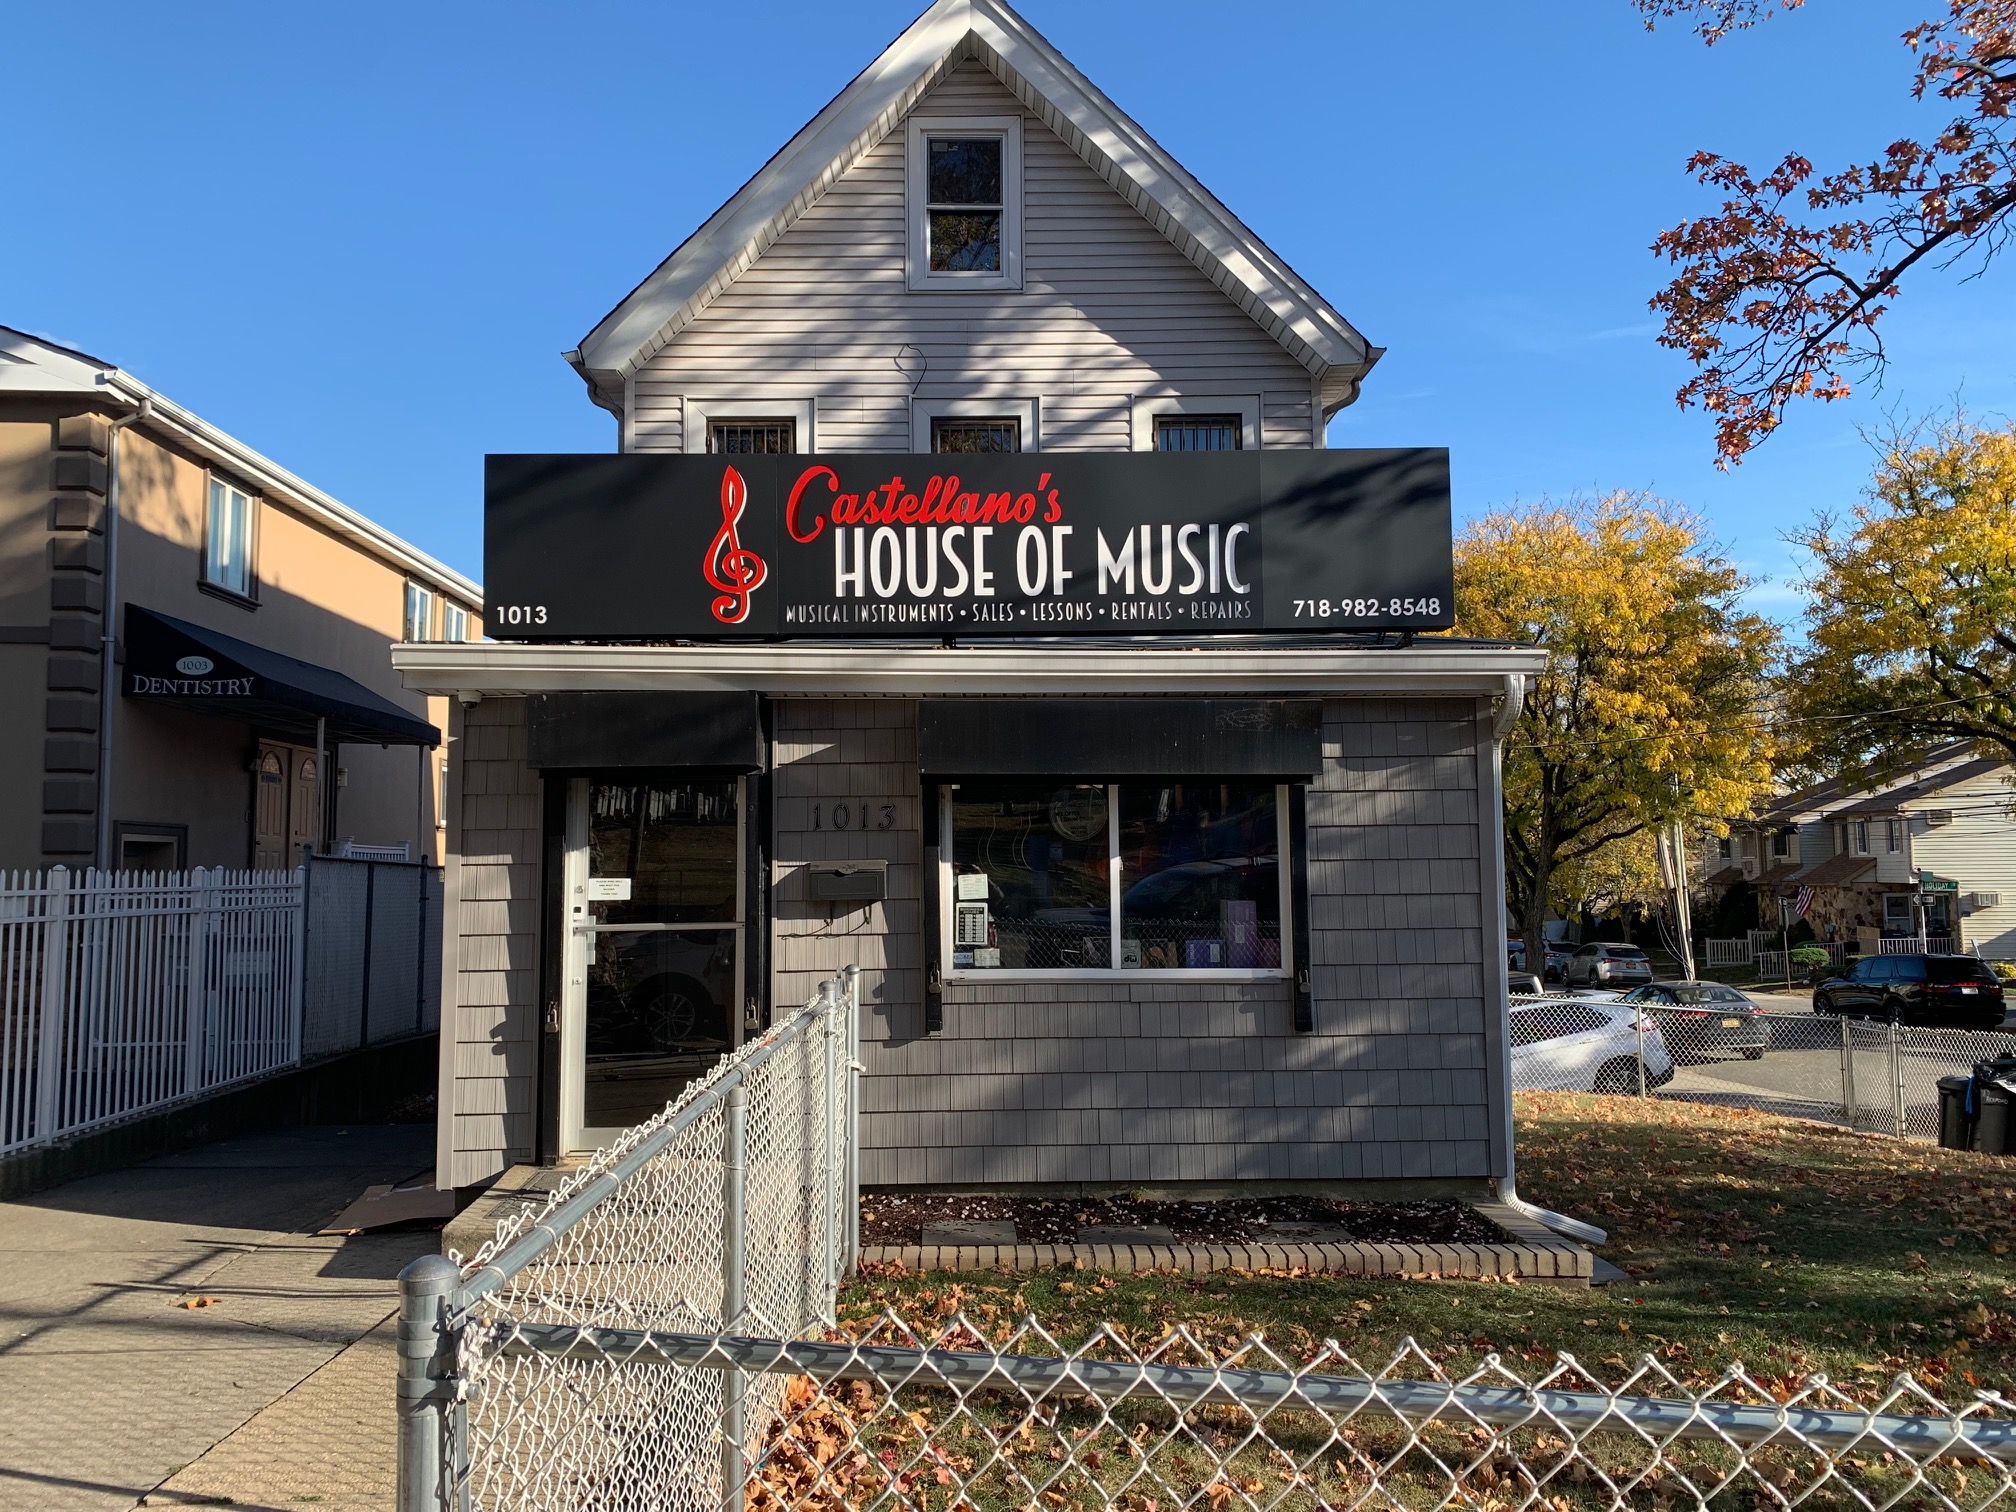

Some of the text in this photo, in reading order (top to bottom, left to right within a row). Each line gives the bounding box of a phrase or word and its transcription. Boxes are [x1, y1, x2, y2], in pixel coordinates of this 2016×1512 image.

[785, 464, 1063, 545] Castellano's
[833, 522, 1251, 598] HOUSE OF MUSIC
[496, 605, 548, 625] 1013
[786, 600, 1251, 623] MUSICAL INSTRUMENTS SALES LESSONS RENTALS REPAIRS
[1292, 597, 1441, 618] 718-982-8548
[182, 661, 208, 671] 1003
[132, 674, 255, 696] DENTISTRY
[812, 803, 896, 831] 1013
[1924, 882, 1949, 890] HOLIDAY
